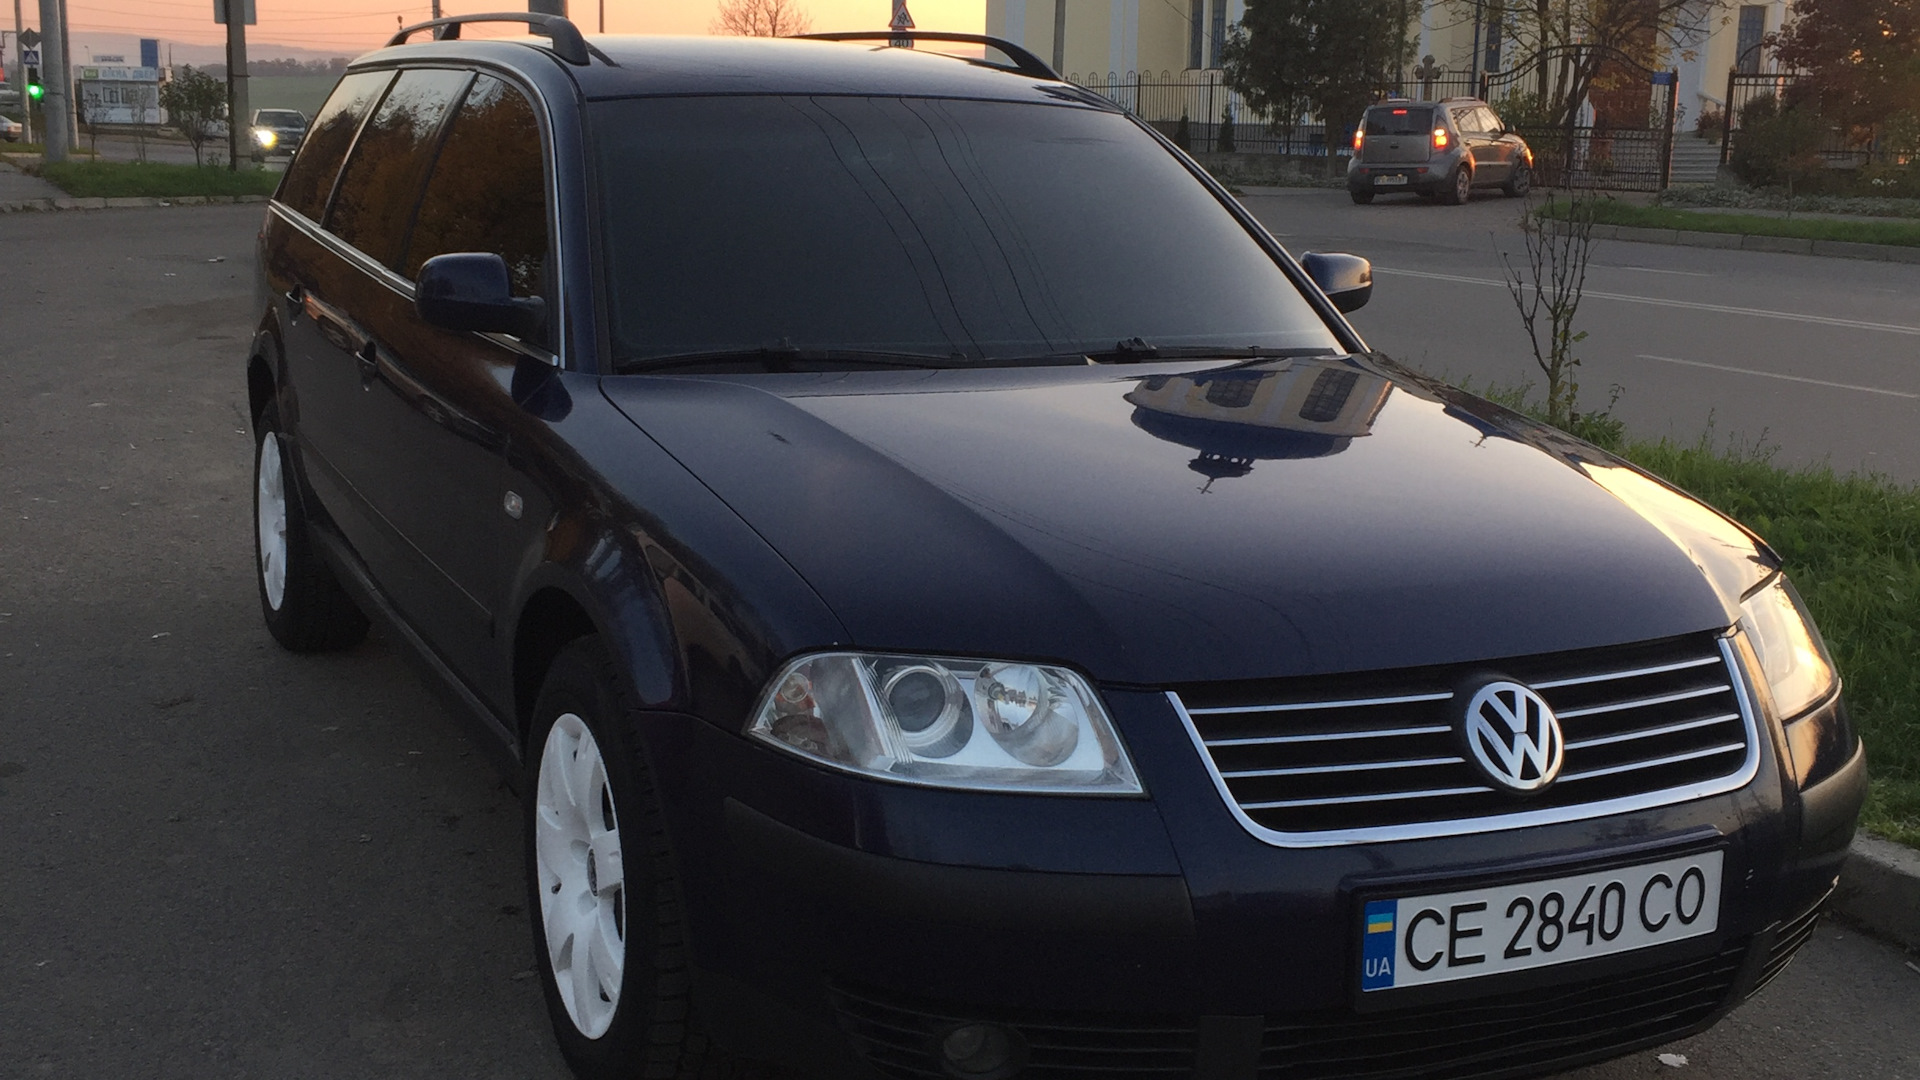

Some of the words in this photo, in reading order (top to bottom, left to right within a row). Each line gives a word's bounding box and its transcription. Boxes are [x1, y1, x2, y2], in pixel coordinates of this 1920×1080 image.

[1404, 902, 1487, 972] CE
[1503, 881, 1626, 960] 2840
[1639, 866, 1706, 933] CO
[1365, 957, 1392, 979] UA
